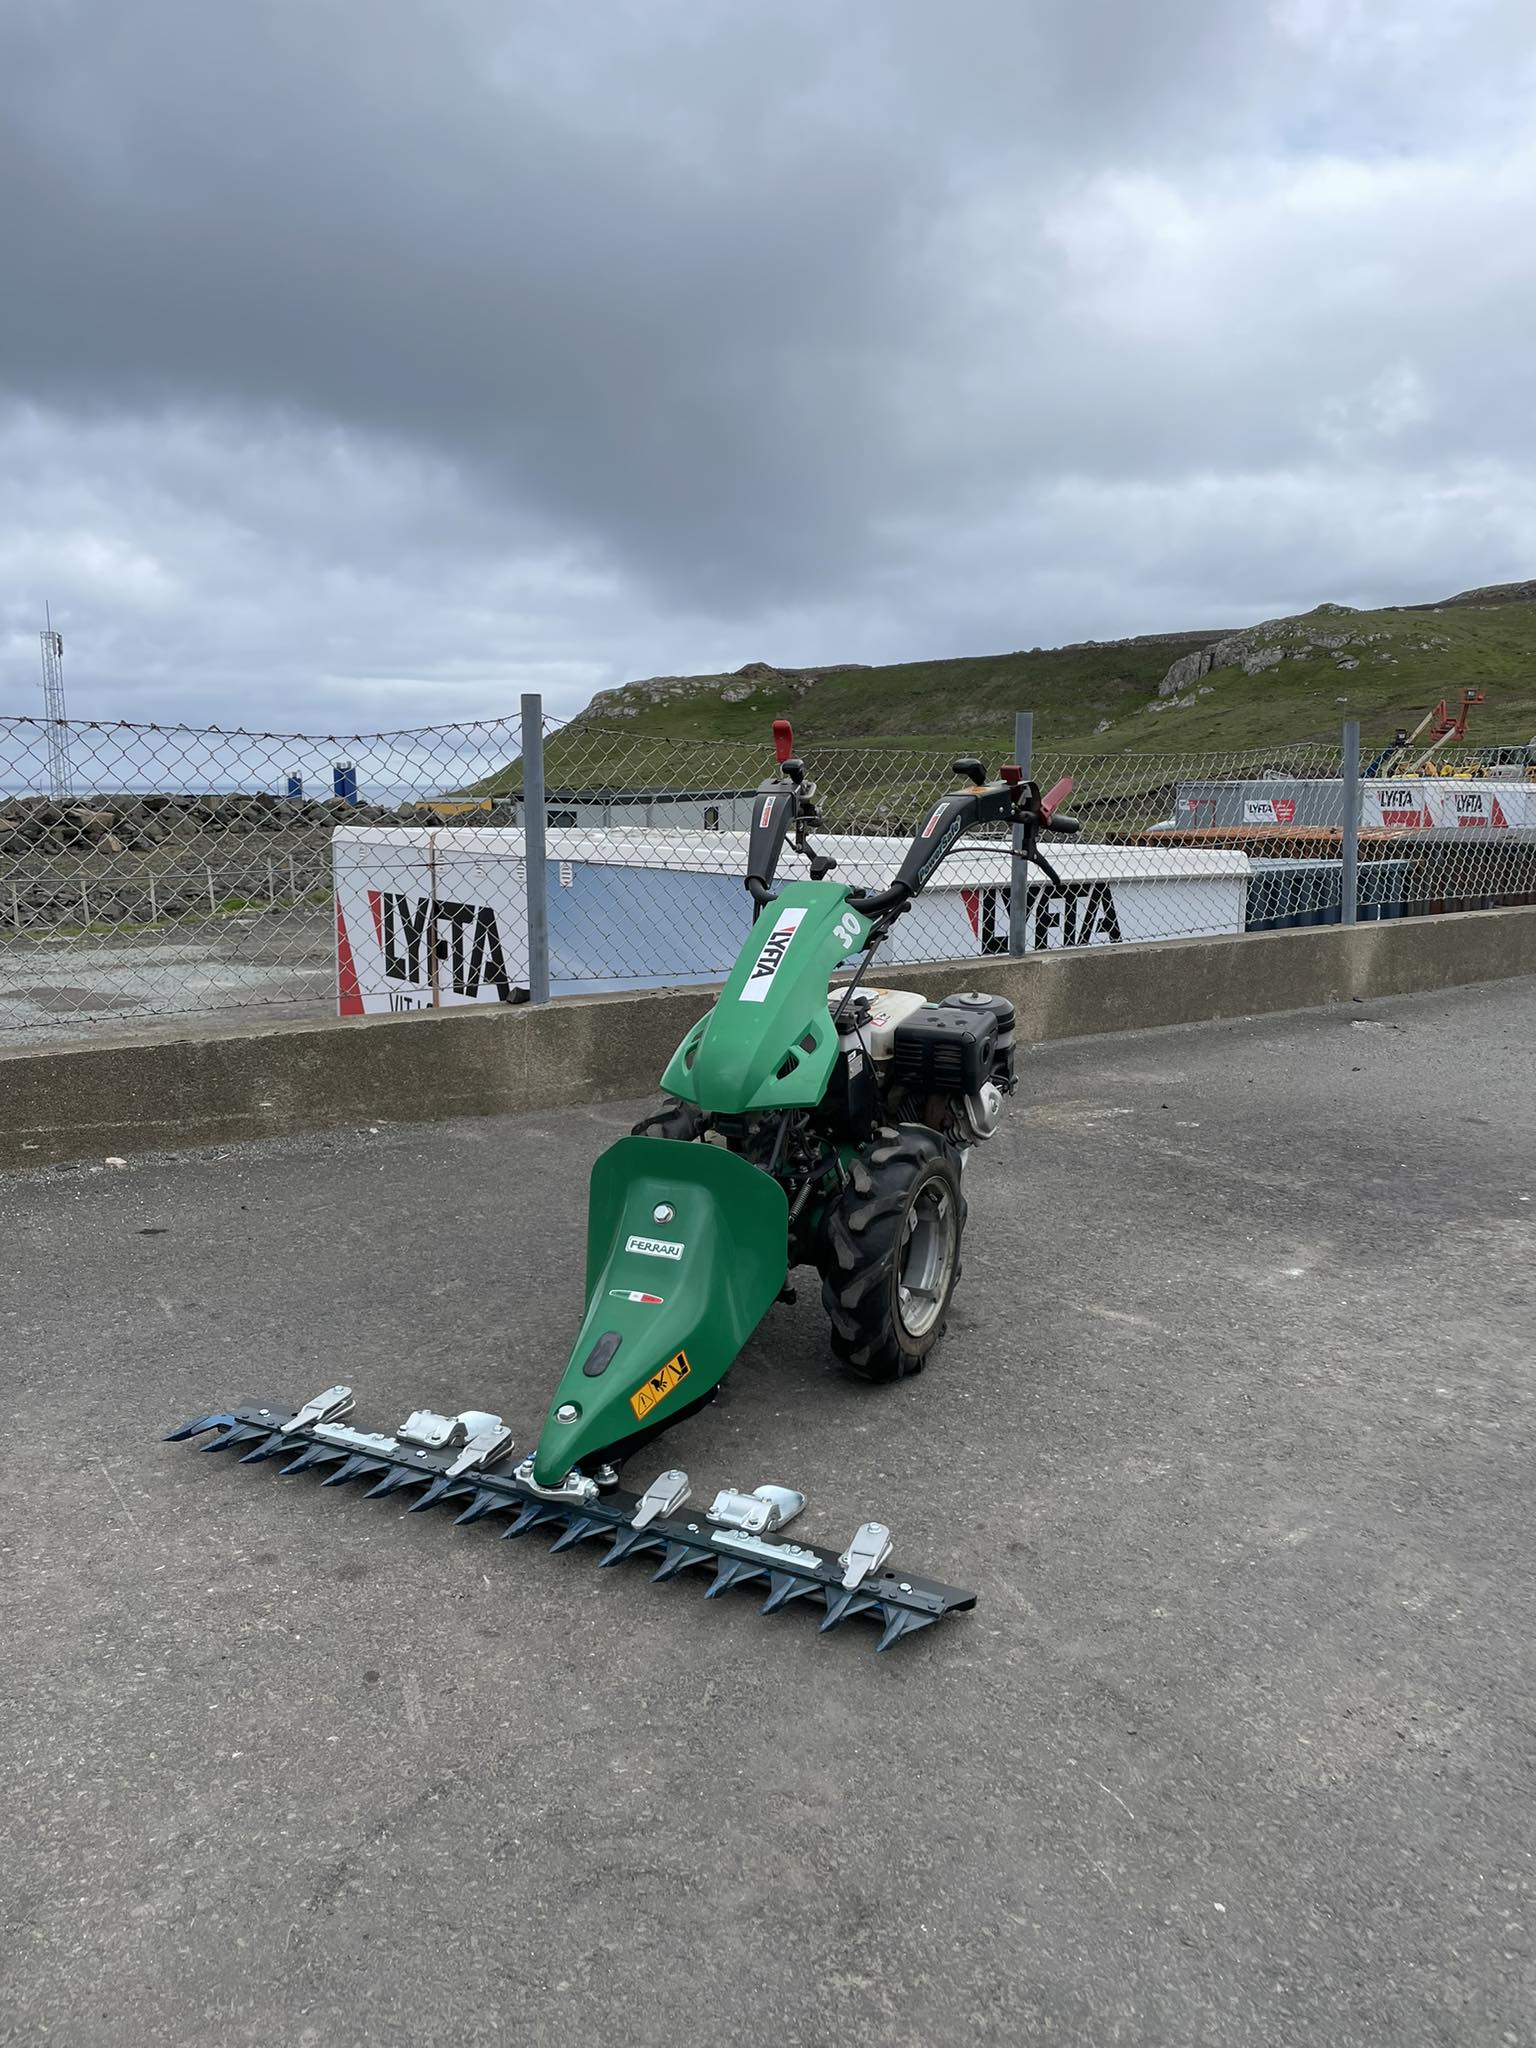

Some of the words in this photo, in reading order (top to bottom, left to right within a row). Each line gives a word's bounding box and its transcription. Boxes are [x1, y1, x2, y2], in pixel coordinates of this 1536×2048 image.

[1380, 790, 1413, 807] LYFTA
[1457, 795, 1482, 812] LYFTA
[1249, 804, 1273, 813] LYFTA
[833, 912, 861, 949] 30
[384, 893, 509, 1001] LYFTA
[751, 932, 793, 979] LYFTA
[630, 1240, 680, 1255] FERRARI
